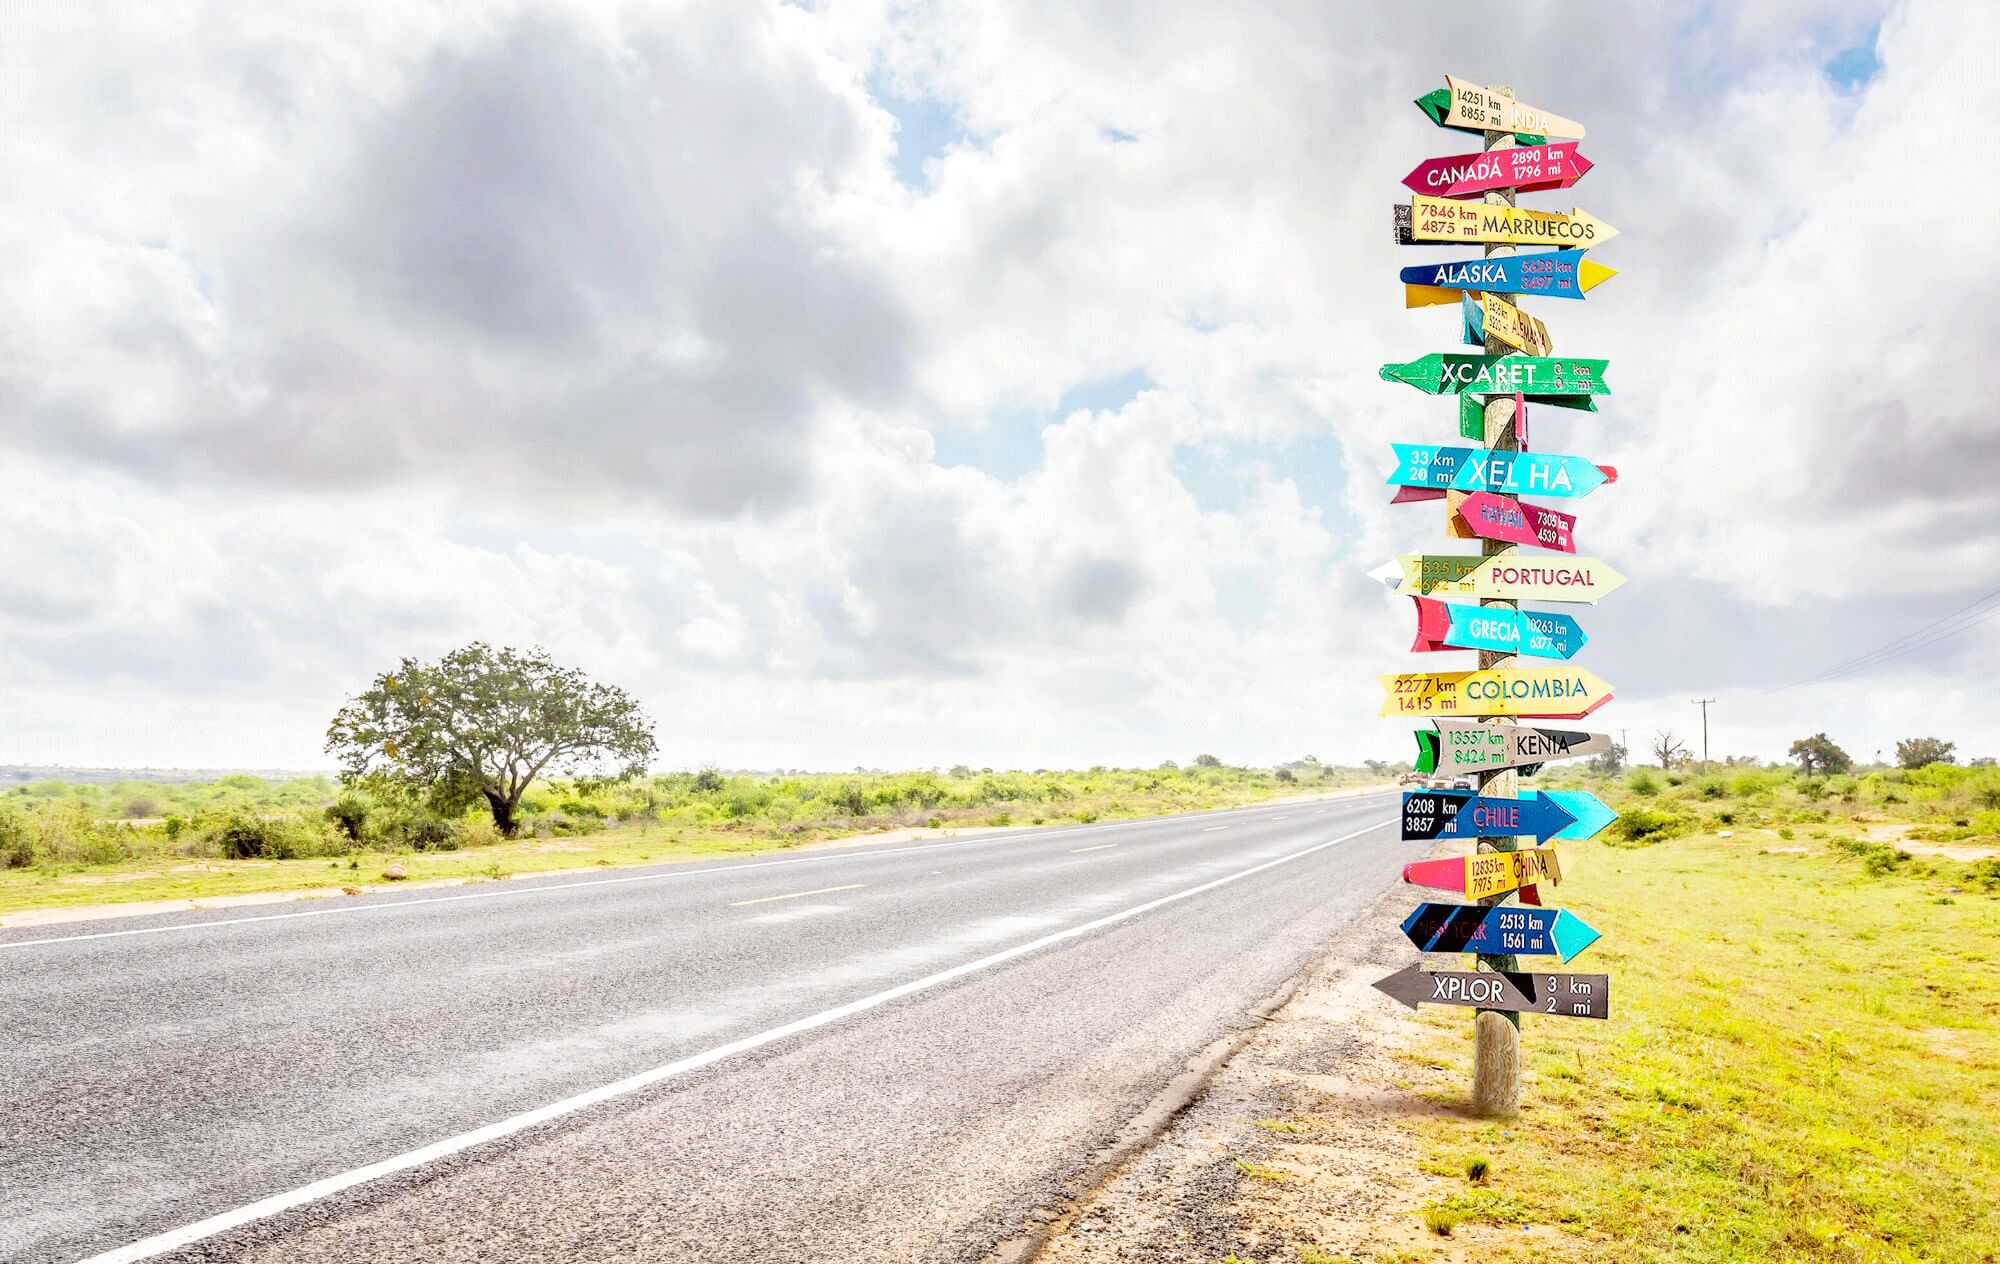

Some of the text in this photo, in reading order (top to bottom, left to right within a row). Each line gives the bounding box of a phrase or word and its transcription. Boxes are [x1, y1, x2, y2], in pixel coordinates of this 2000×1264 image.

[1457, 88, 1501, 111] 14251 km
[1461, 105, 1501, 126] 8855 mi
[1510, 107, 1550, 131] INDIA
[1511, 148, 1563, 166] 2890 km
[1427, 157, 1502, 187] CANADÁ
[1514, 162, 1561, 180] 1796 mi
[1420, 204, 1477, 221] 7846 km
[1420, 219, 1478, 236] 4875 mi
[1483, 215, 1595, 240] MARRUECOS
[1434, 264, 1508, 284] ALASKA
[1521, 259, 1573, 273] 5628 km
[1521, 275, 1572, 289] 3497 mi
[1441, 362, 1537, 385] XCARET
[1573, 360, 1591, 376] km
[1578, 376, 1592, 389] mi
[1410, 451, 1454, 467] 33 km
[1409, 467, 1454, 483] 20 mi
[1468, 457, 1573, 492] XEL HÁ
[1481, 503, 1523, 529] HAWAII
[1537, 511, 1569, 531] 7305 km
[1538, 527, 1568, 547] 4539 mi
[1455, 559, 1475, 576] km
[1492, 566, 1595, 587] PORTUGAL
[1459, 578, 1475, 592] mi
[1469, 618, 1521, 643] GRECIA
[1526, 619, 1567, 635] 10263 km
[1529, 636, 1567, 652] 6377 mi
[1394, 677, 1456, 694] 2277 km
[1466, 677, 1588, 701] COLOMBIA
[1399, 695, 1457, 711] 1415 mi
[1448, 729, 1505, 746] 13557 km
[1517, 734, 1571, 756] KENIA
[1454, 749, 1505, 765] 8424 mi
[1406, 798, 1457, 815] 6208 km
[1406, 817, 1457, 833] 3857 mi
[1473, 804, 1520, 828] CHILE
[1471, 857, 1505, 877] 12835 km
[1513, 854, 1548, 880] CHINA
[1473, 874, 1506, 894] 7975 mi
[1500, 913, 1543, 931] 2513 km
[1503, 932, 1543, 950] 1561 mi
[1432, 975, 1504, 1003] XPLOR
[1547, 975, 1591, 995] 3 km
[1547, 996, 1591, 1015] 2 mi
